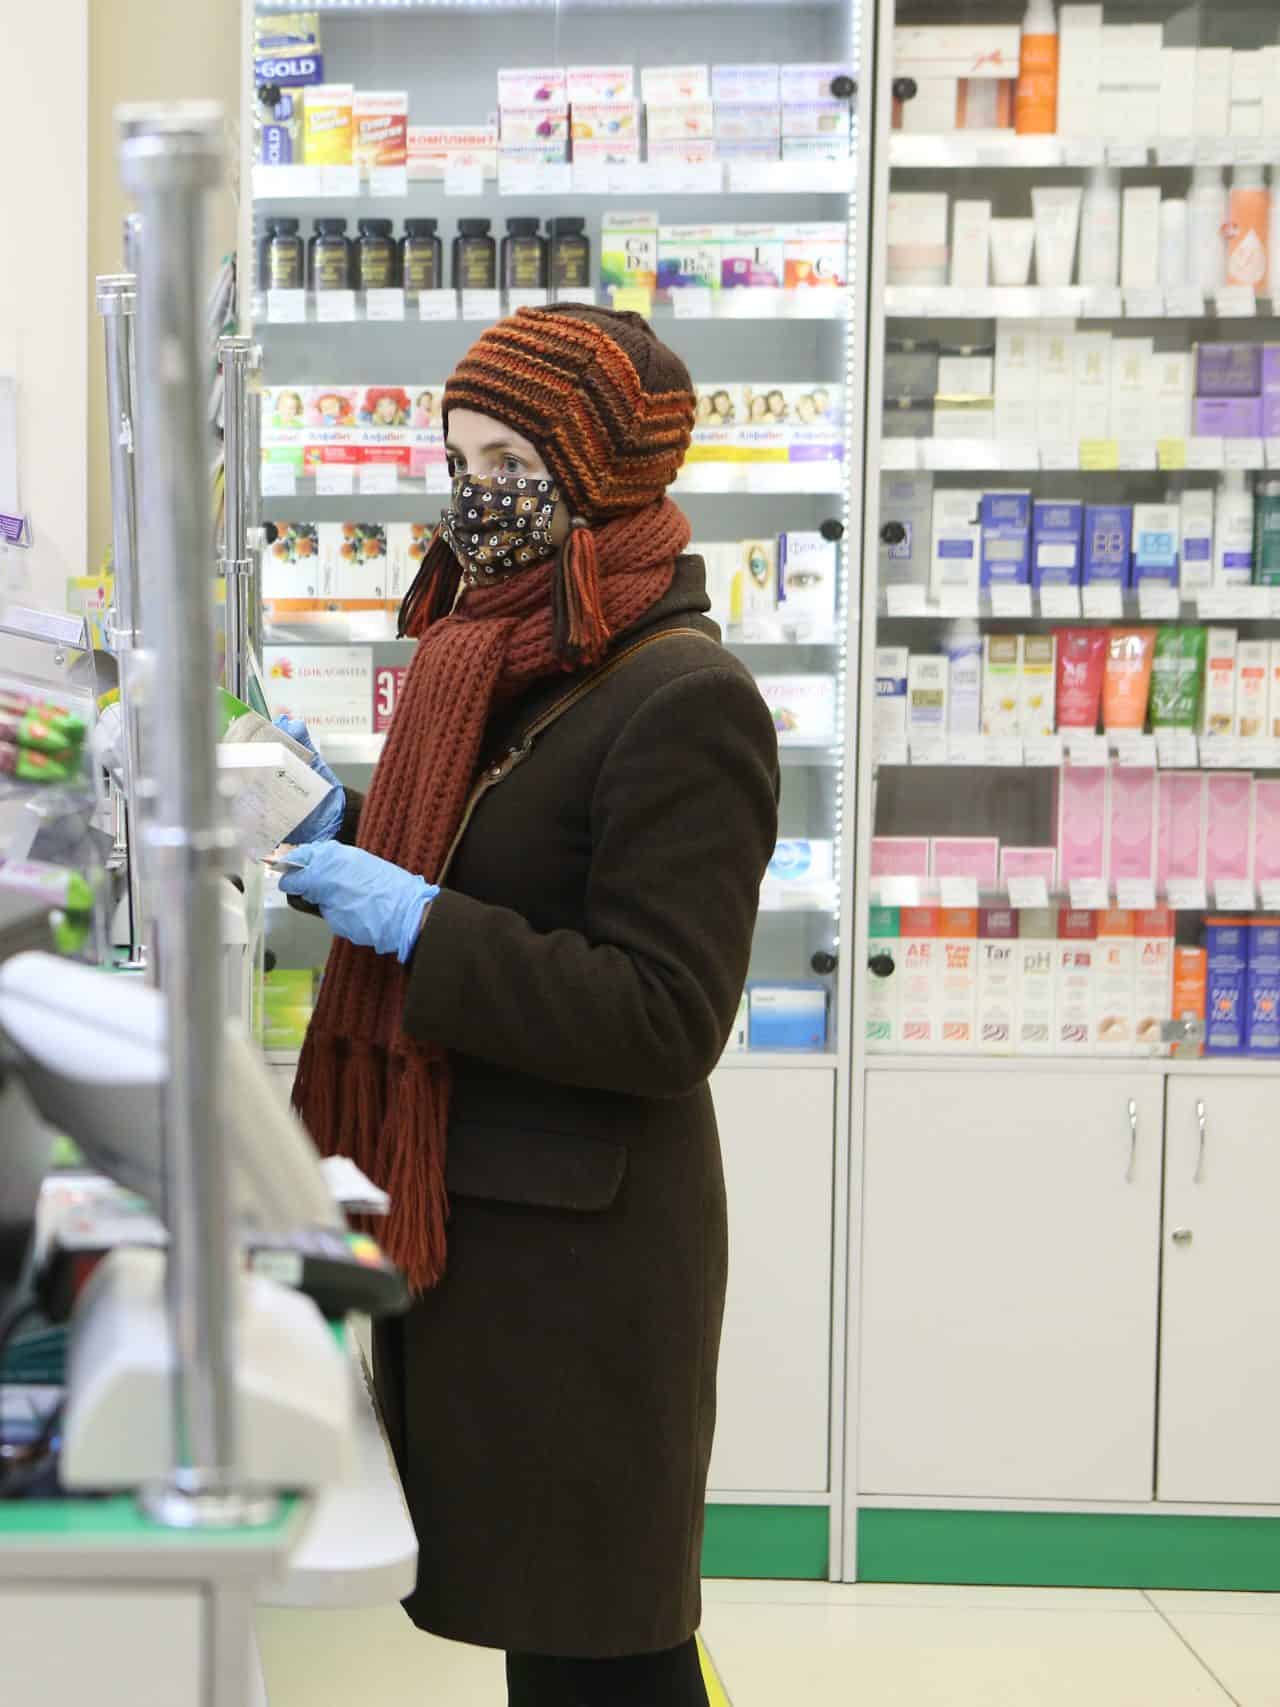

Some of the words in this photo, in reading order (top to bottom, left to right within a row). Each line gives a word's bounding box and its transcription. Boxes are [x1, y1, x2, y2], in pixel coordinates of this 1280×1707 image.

[261, 59, 316, 78] GOLD
[625, 239, 649, 253] Ca
[377, 671, 394, 717] 3
[984, 945, 1011, 960] Tar
[1023, 951, 1051, 972] pH
